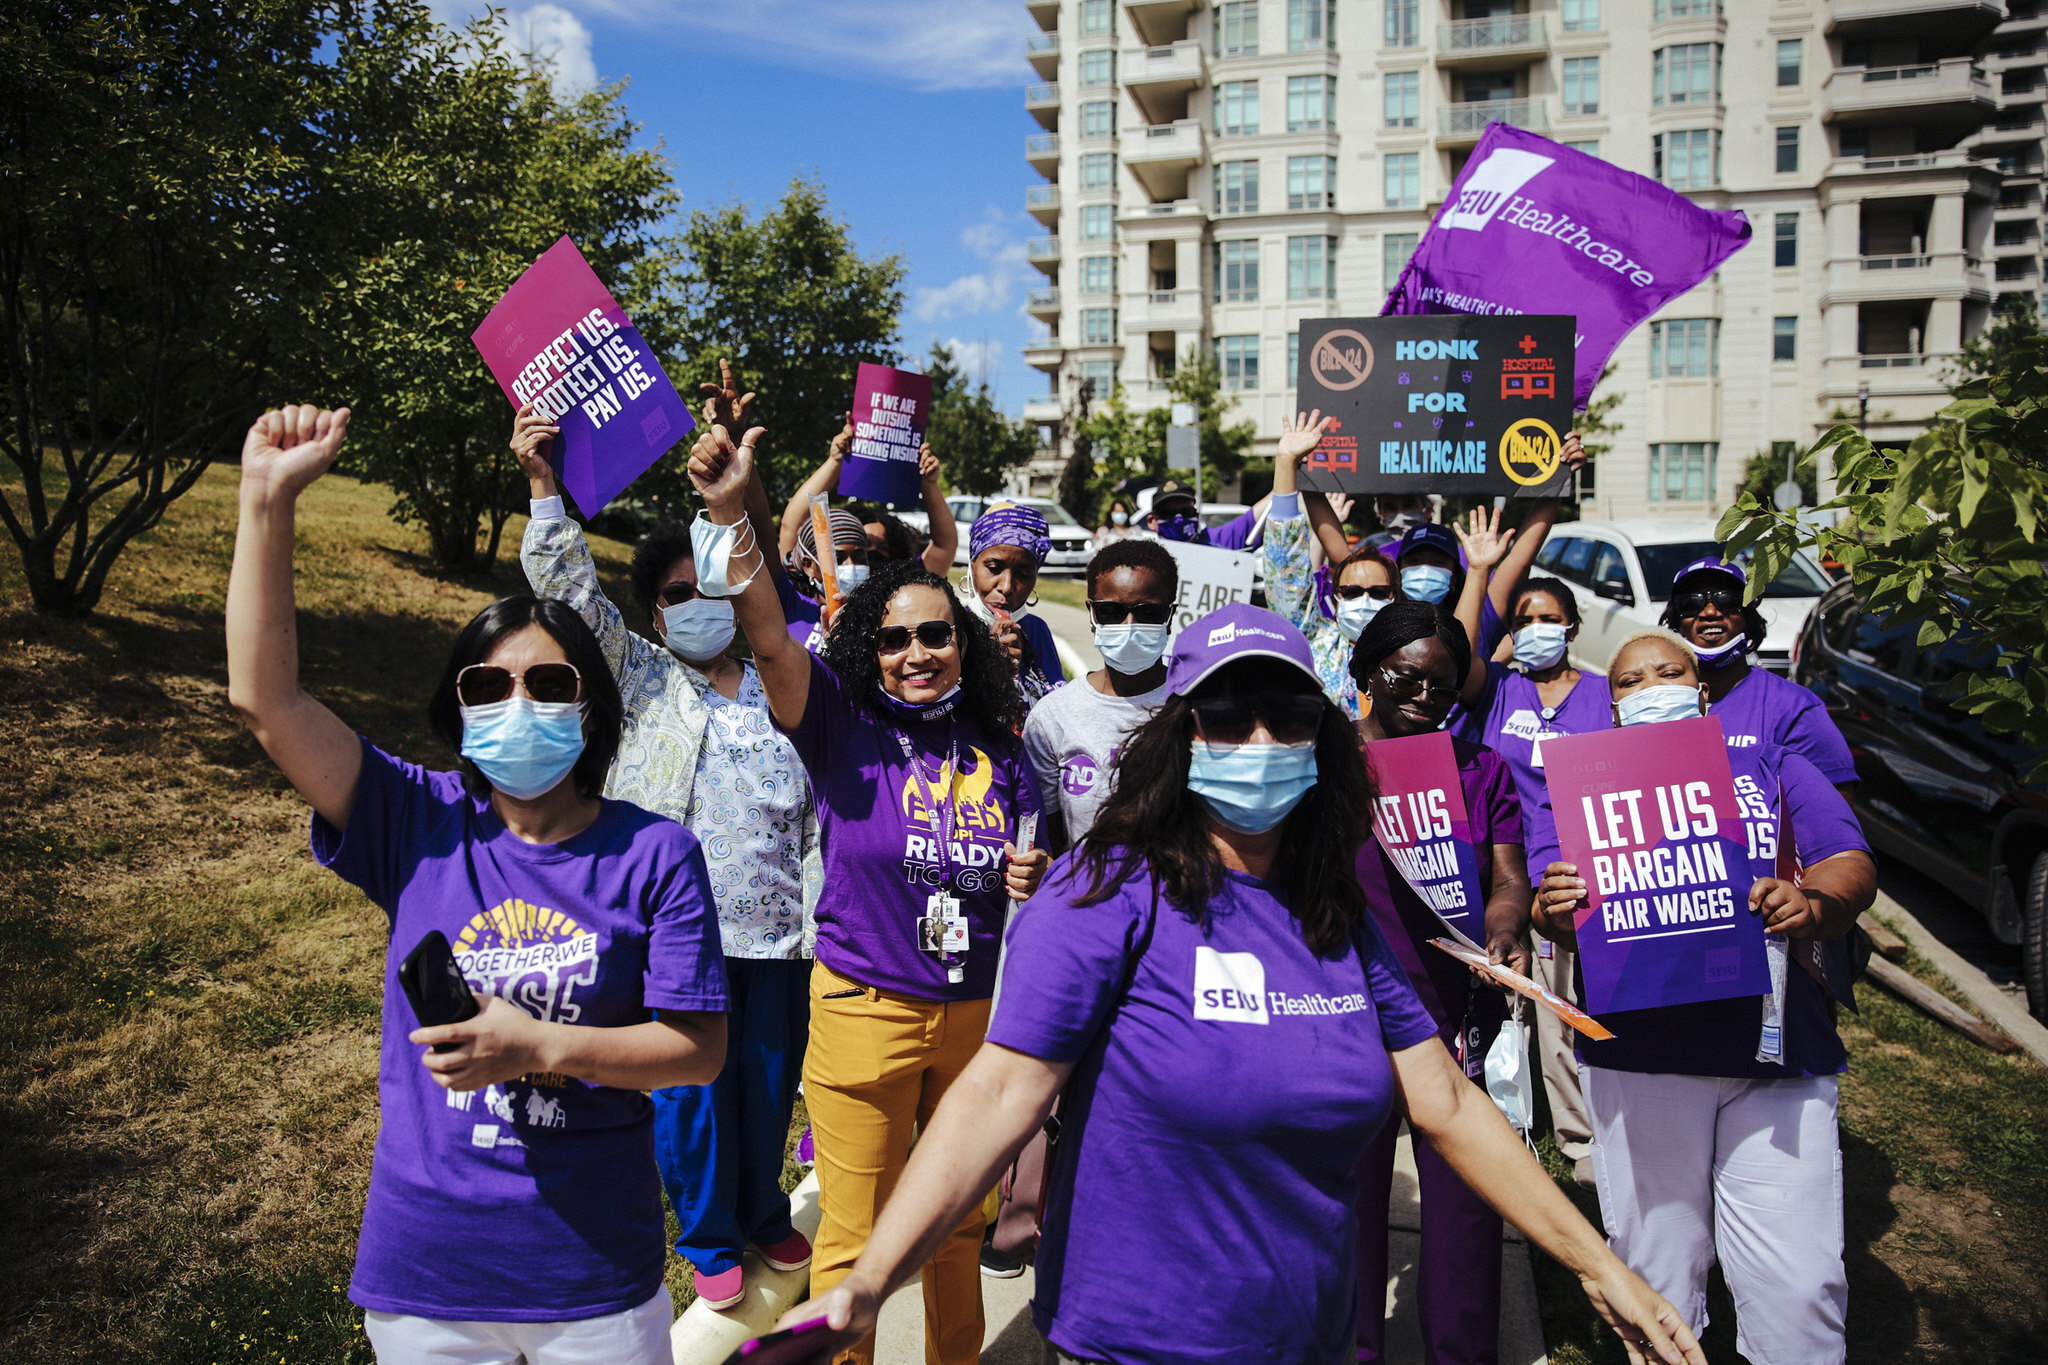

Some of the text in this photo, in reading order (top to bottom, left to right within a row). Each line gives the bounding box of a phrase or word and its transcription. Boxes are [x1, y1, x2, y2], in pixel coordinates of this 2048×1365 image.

[1497, 196, 1654, 288] Healthcare
[511, 307, 621, 406] RESPECT US.
[597, 335, 640, 374] US.
[1396, 339, 1479, 361] HONK
[1502, 357, 1555, 371] HOSPITAL
[581, 361, 657, 430] PAY US.
[870, 392, 917, 415] IF WE ARE
[1408, 392, 1467, 413] FOR
[851, 438, 920, 463] WRONG INSIDE
[855, 421, 921, 448] SOMETHING IS
[1319, 436, 1358, 447] SPITAL
[1379, 440, 1487, 474] HEALTHCARE
[1508, 721, 1534, 735] SEIU
[1407, 788, 1452, 841] US
[1581, 780, 1719, 851] LET US
[905, 834, 1005, 870] READY
[1391, 840, 1460, 881] BARGAIN
[903, 859, 1001, 893] TO GO
[1592, 841, 1728, 896] BARGAIN
[1425, 880, 1467, 911] WAGES
[1601, 887, 1735, 932] FAIR WAGES
[562, 937, 593, 961] WE
[1708, 965, 1737, 978] SEIU
[1203, 988, 1368, 1016] SEIU Healthcare
